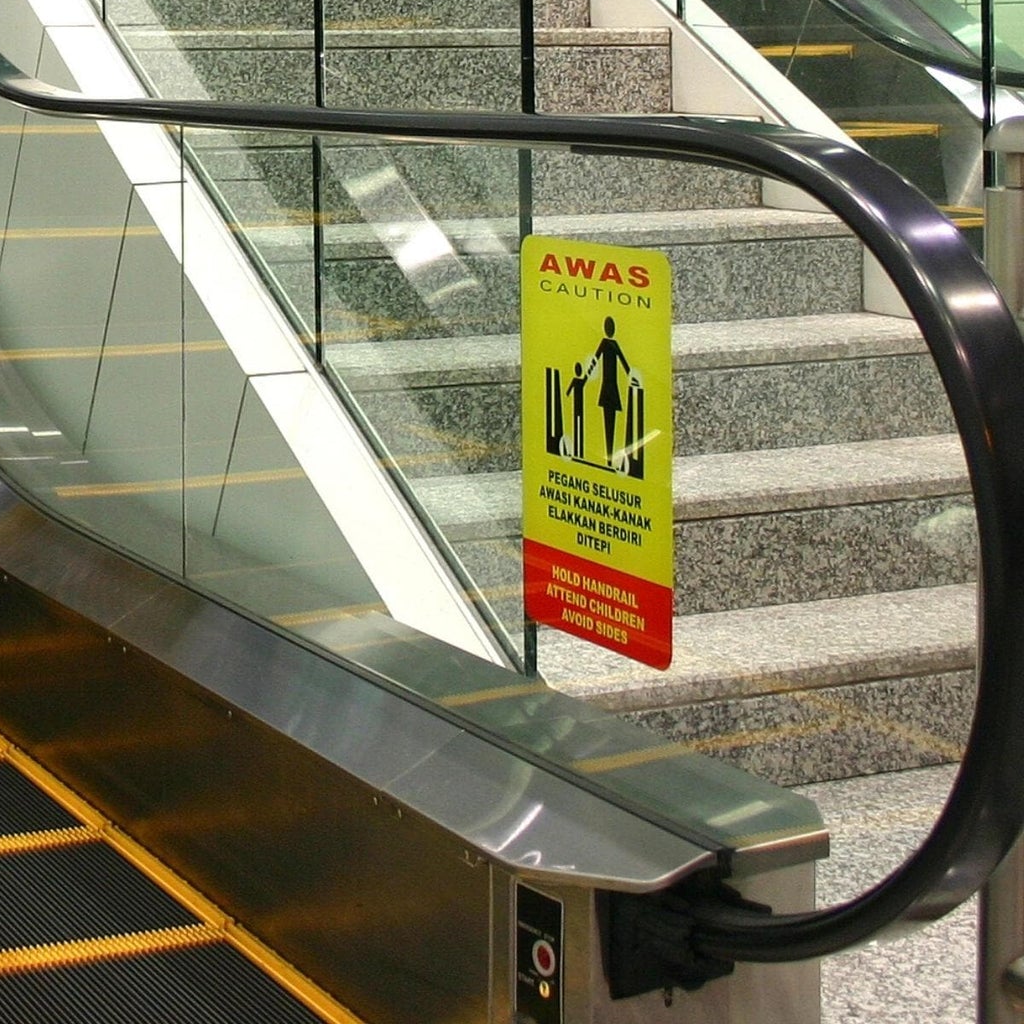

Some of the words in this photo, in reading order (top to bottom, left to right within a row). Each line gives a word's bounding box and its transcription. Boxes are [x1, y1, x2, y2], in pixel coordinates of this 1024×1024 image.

[539, 253, 650, 288] AWAS
[540, 279, 651, 309] CAUTION
[539, 485, 571, 506] AWASI
[574, 496, 652, 532] KANAK-KANAK
[548, 469, 590, 494] PEGANG
[592, 482, 642, 509] SELUSUR
[548, 505, 596, 532] ELAKKAN
[599, 521, 642, 547] BERDIRI
[577, 532, 611, 555] DITEPI
[546, 583, 587, 608] ATTEND
[589, 599, 645, 631] CHILDREN
[552, 565, 580, 587] HOLD
[582, 575, 638, 609] HANDRAIL
[561, 607, 594, 631] AVOID
[595, 621, 628, 645] SIDES
